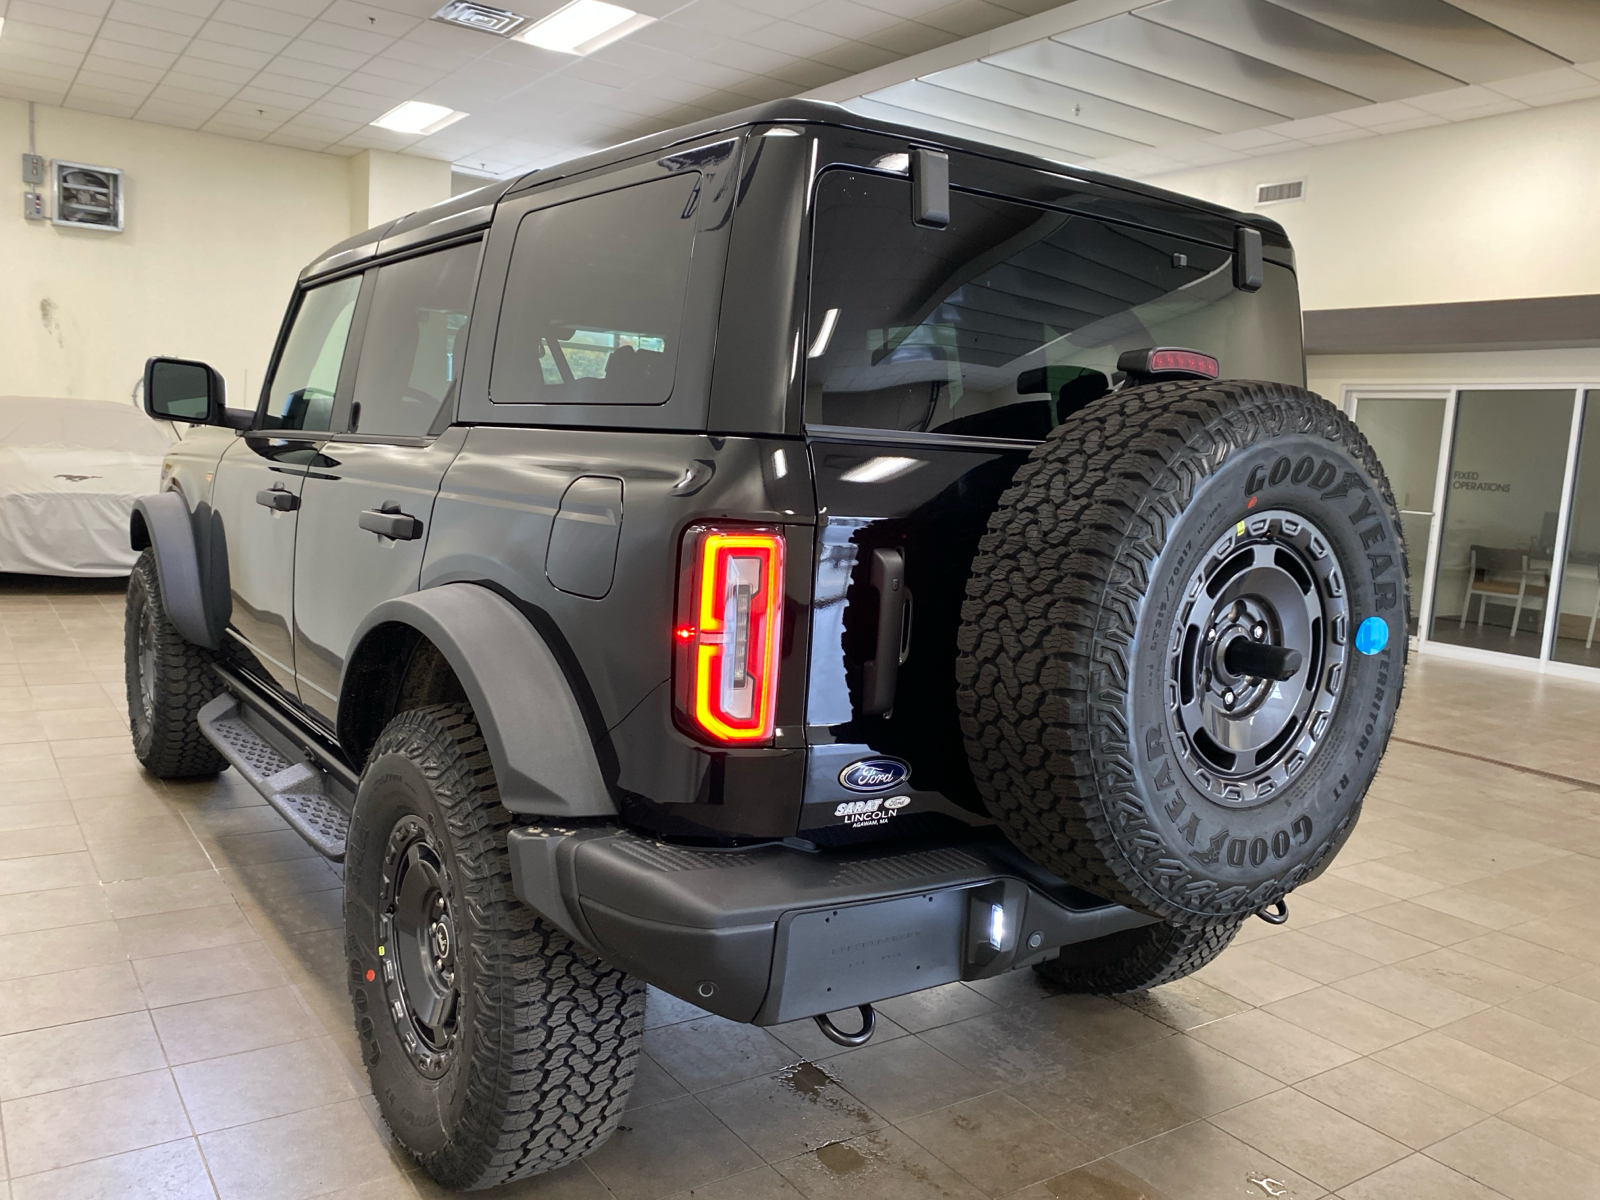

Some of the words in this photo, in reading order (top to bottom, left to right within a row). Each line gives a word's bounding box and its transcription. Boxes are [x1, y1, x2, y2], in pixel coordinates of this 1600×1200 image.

[1454, 471, 1479, 480] FIXED
[1453, 481, 1511, 493] OPERATIONS
[1244, 454, 1398, 612] GOODYEAR
[1354, 647, 1392, 763] TERRITORY
[858, 766, 894, 785] Ford
[1145, 722, 1314, 869] GOODYEAR
[1332, 773, 1350, 802] RT
[834, 798, 883, 816] SARAT
[844, 809, 897, 823] LINCOLN
